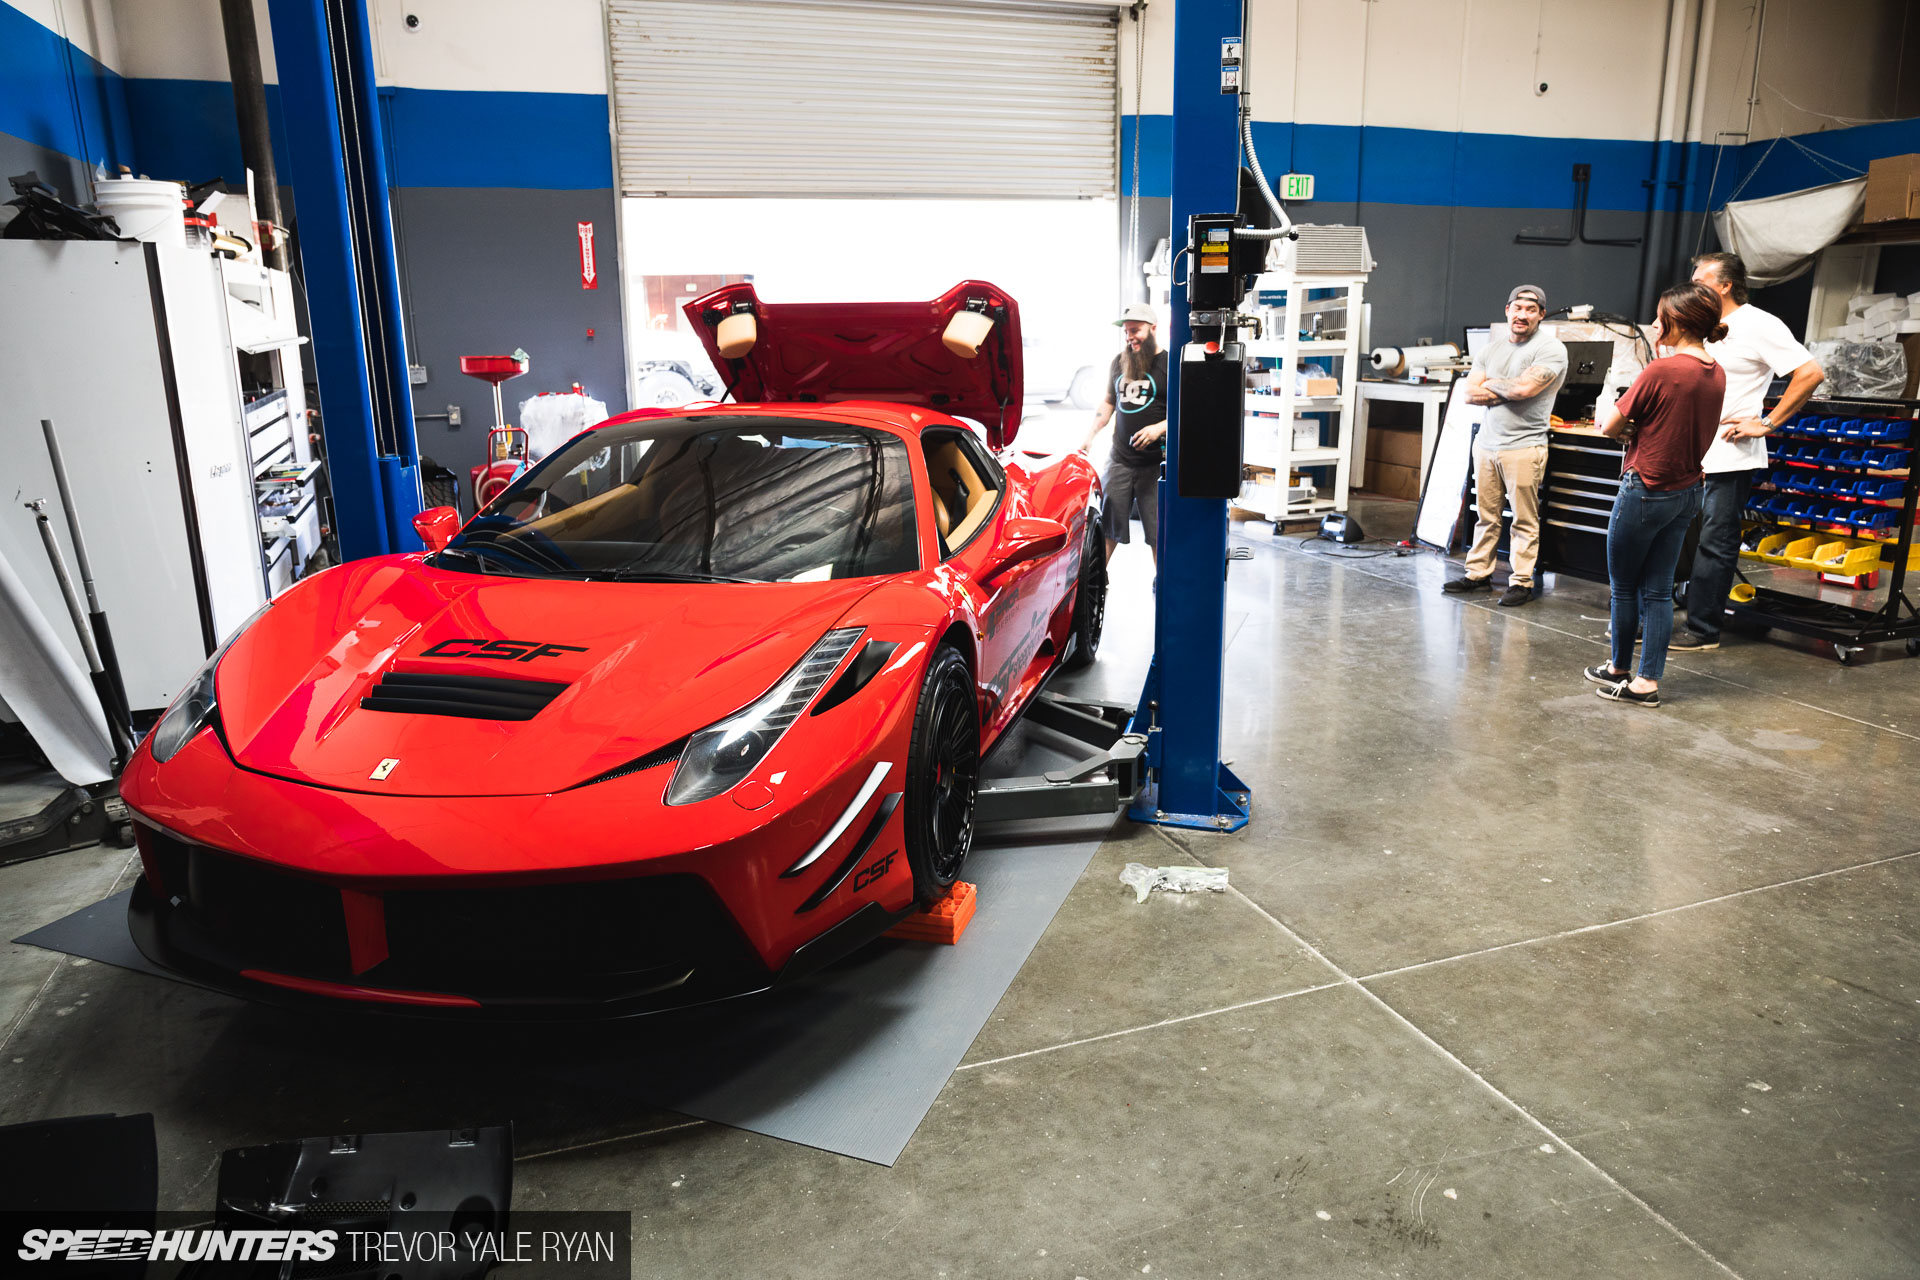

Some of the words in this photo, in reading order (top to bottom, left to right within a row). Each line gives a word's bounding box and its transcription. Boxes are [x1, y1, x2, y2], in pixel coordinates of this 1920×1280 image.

[1288, 176, 1311, 197] EXIT
[1119, 380, 1151, 405] DC
[419, 639, 590, 662] CSF
[853, 849, 898, 893] CSF
